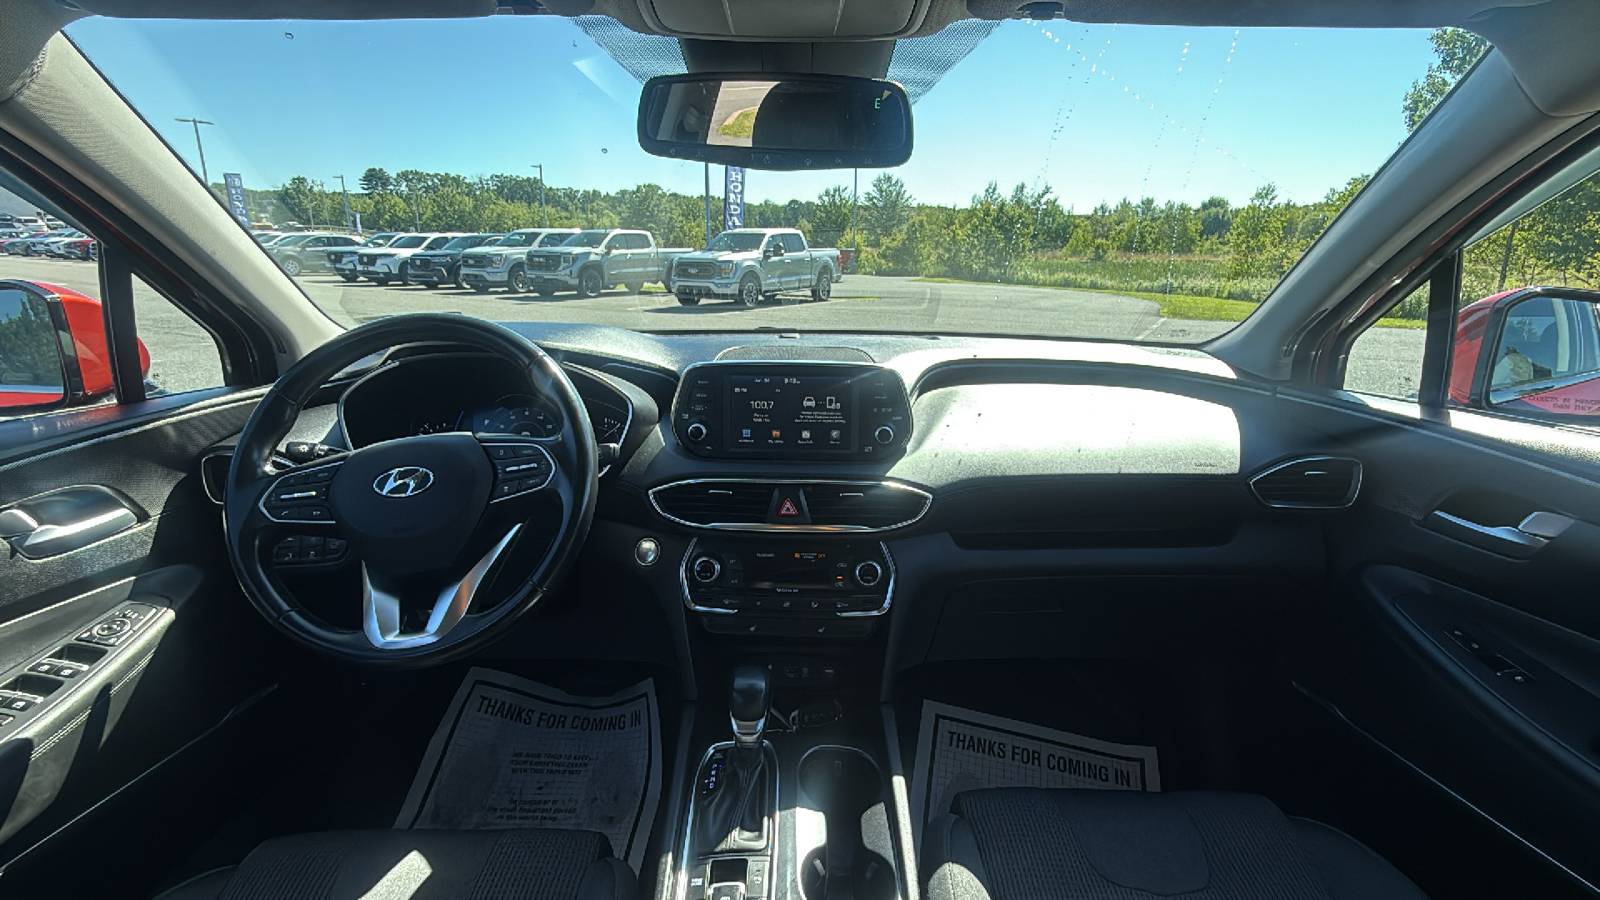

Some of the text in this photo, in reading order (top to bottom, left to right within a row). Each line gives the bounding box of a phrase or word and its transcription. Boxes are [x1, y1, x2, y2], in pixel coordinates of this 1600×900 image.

[873, 98, 881, 109] E
[728, 171, 743, 226] HONDA
[477, 695, 641, 731] THANKS FOR COMING IN
[948, 731, 1131, 788] THANKS FOR COMING IN
